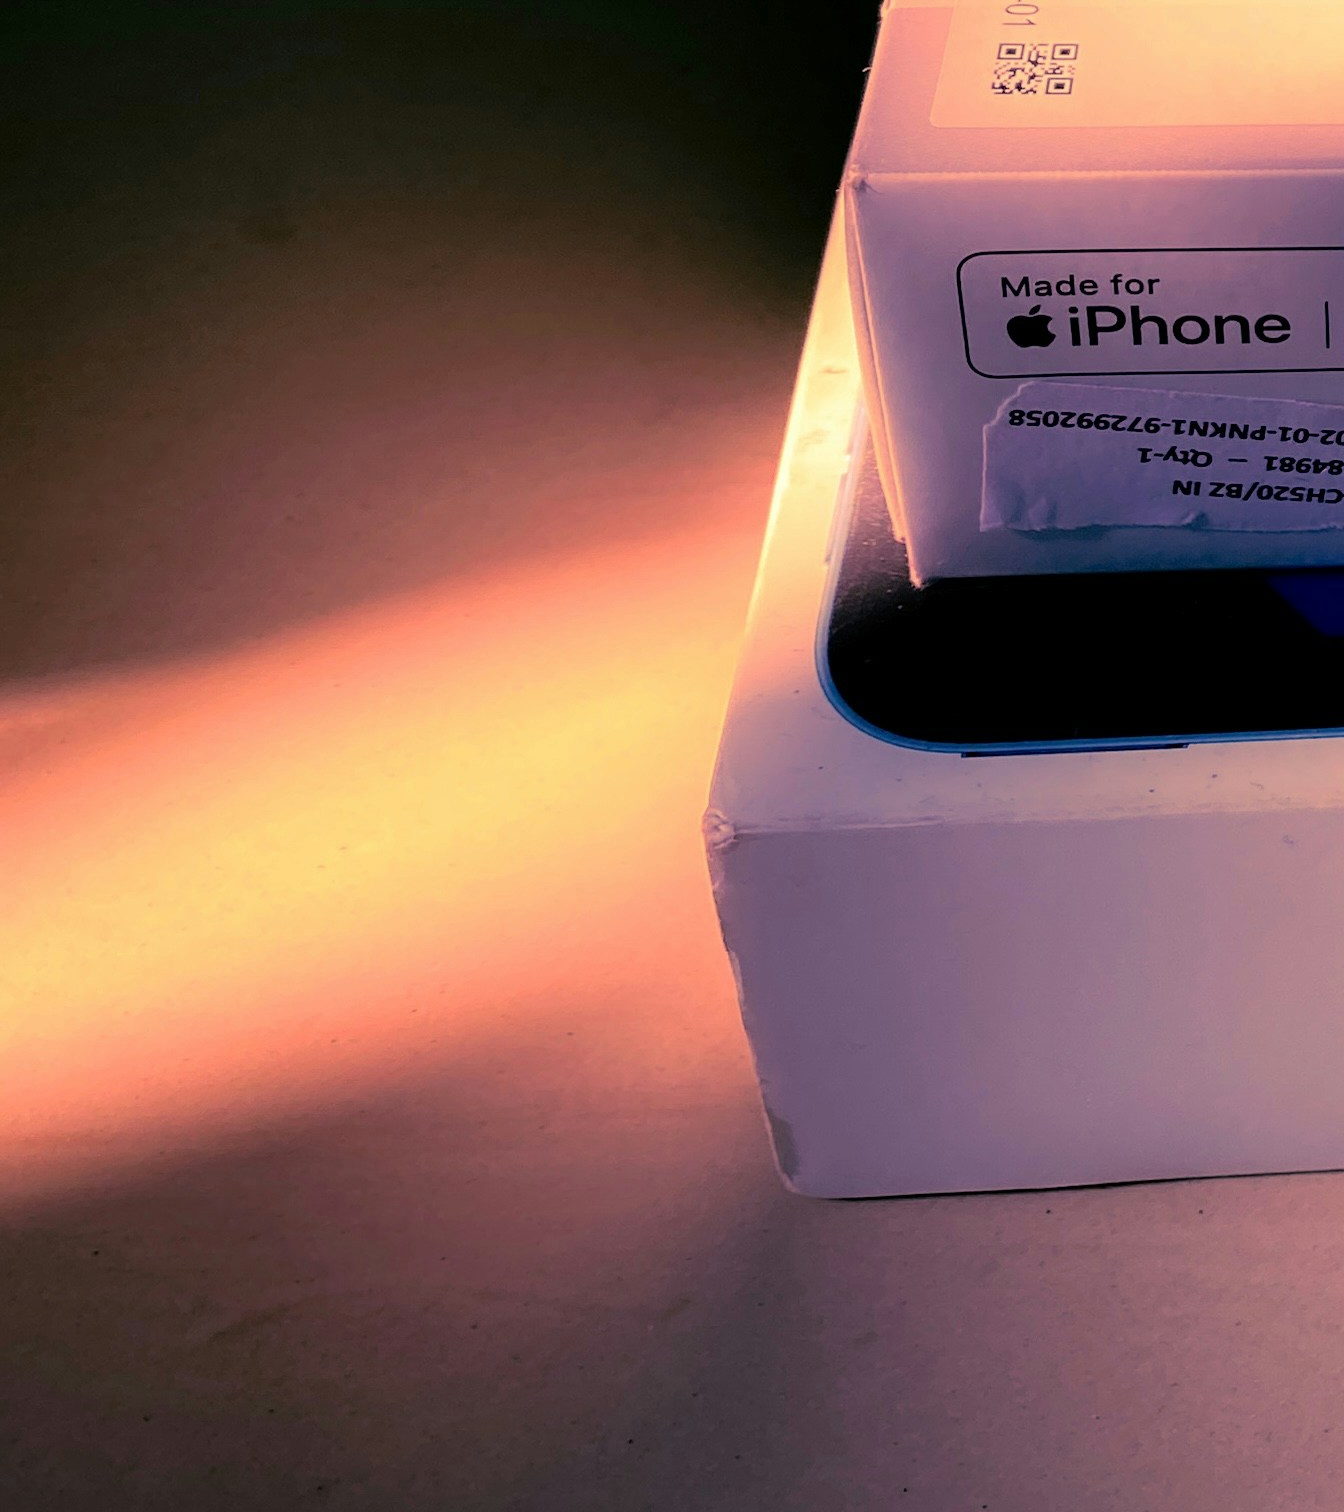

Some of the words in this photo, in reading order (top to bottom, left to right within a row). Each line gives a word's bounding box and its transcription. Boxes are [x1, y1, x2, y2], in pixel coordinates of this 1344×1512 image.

[1001, 274, 1099, 297] Made
[1111, 273, 1160, 295] for
[1068, 305, 1291, 347] iPhone
[1137, 447, 1213, 468] Qty-1
[1172, 479, 1202, 495] IN
